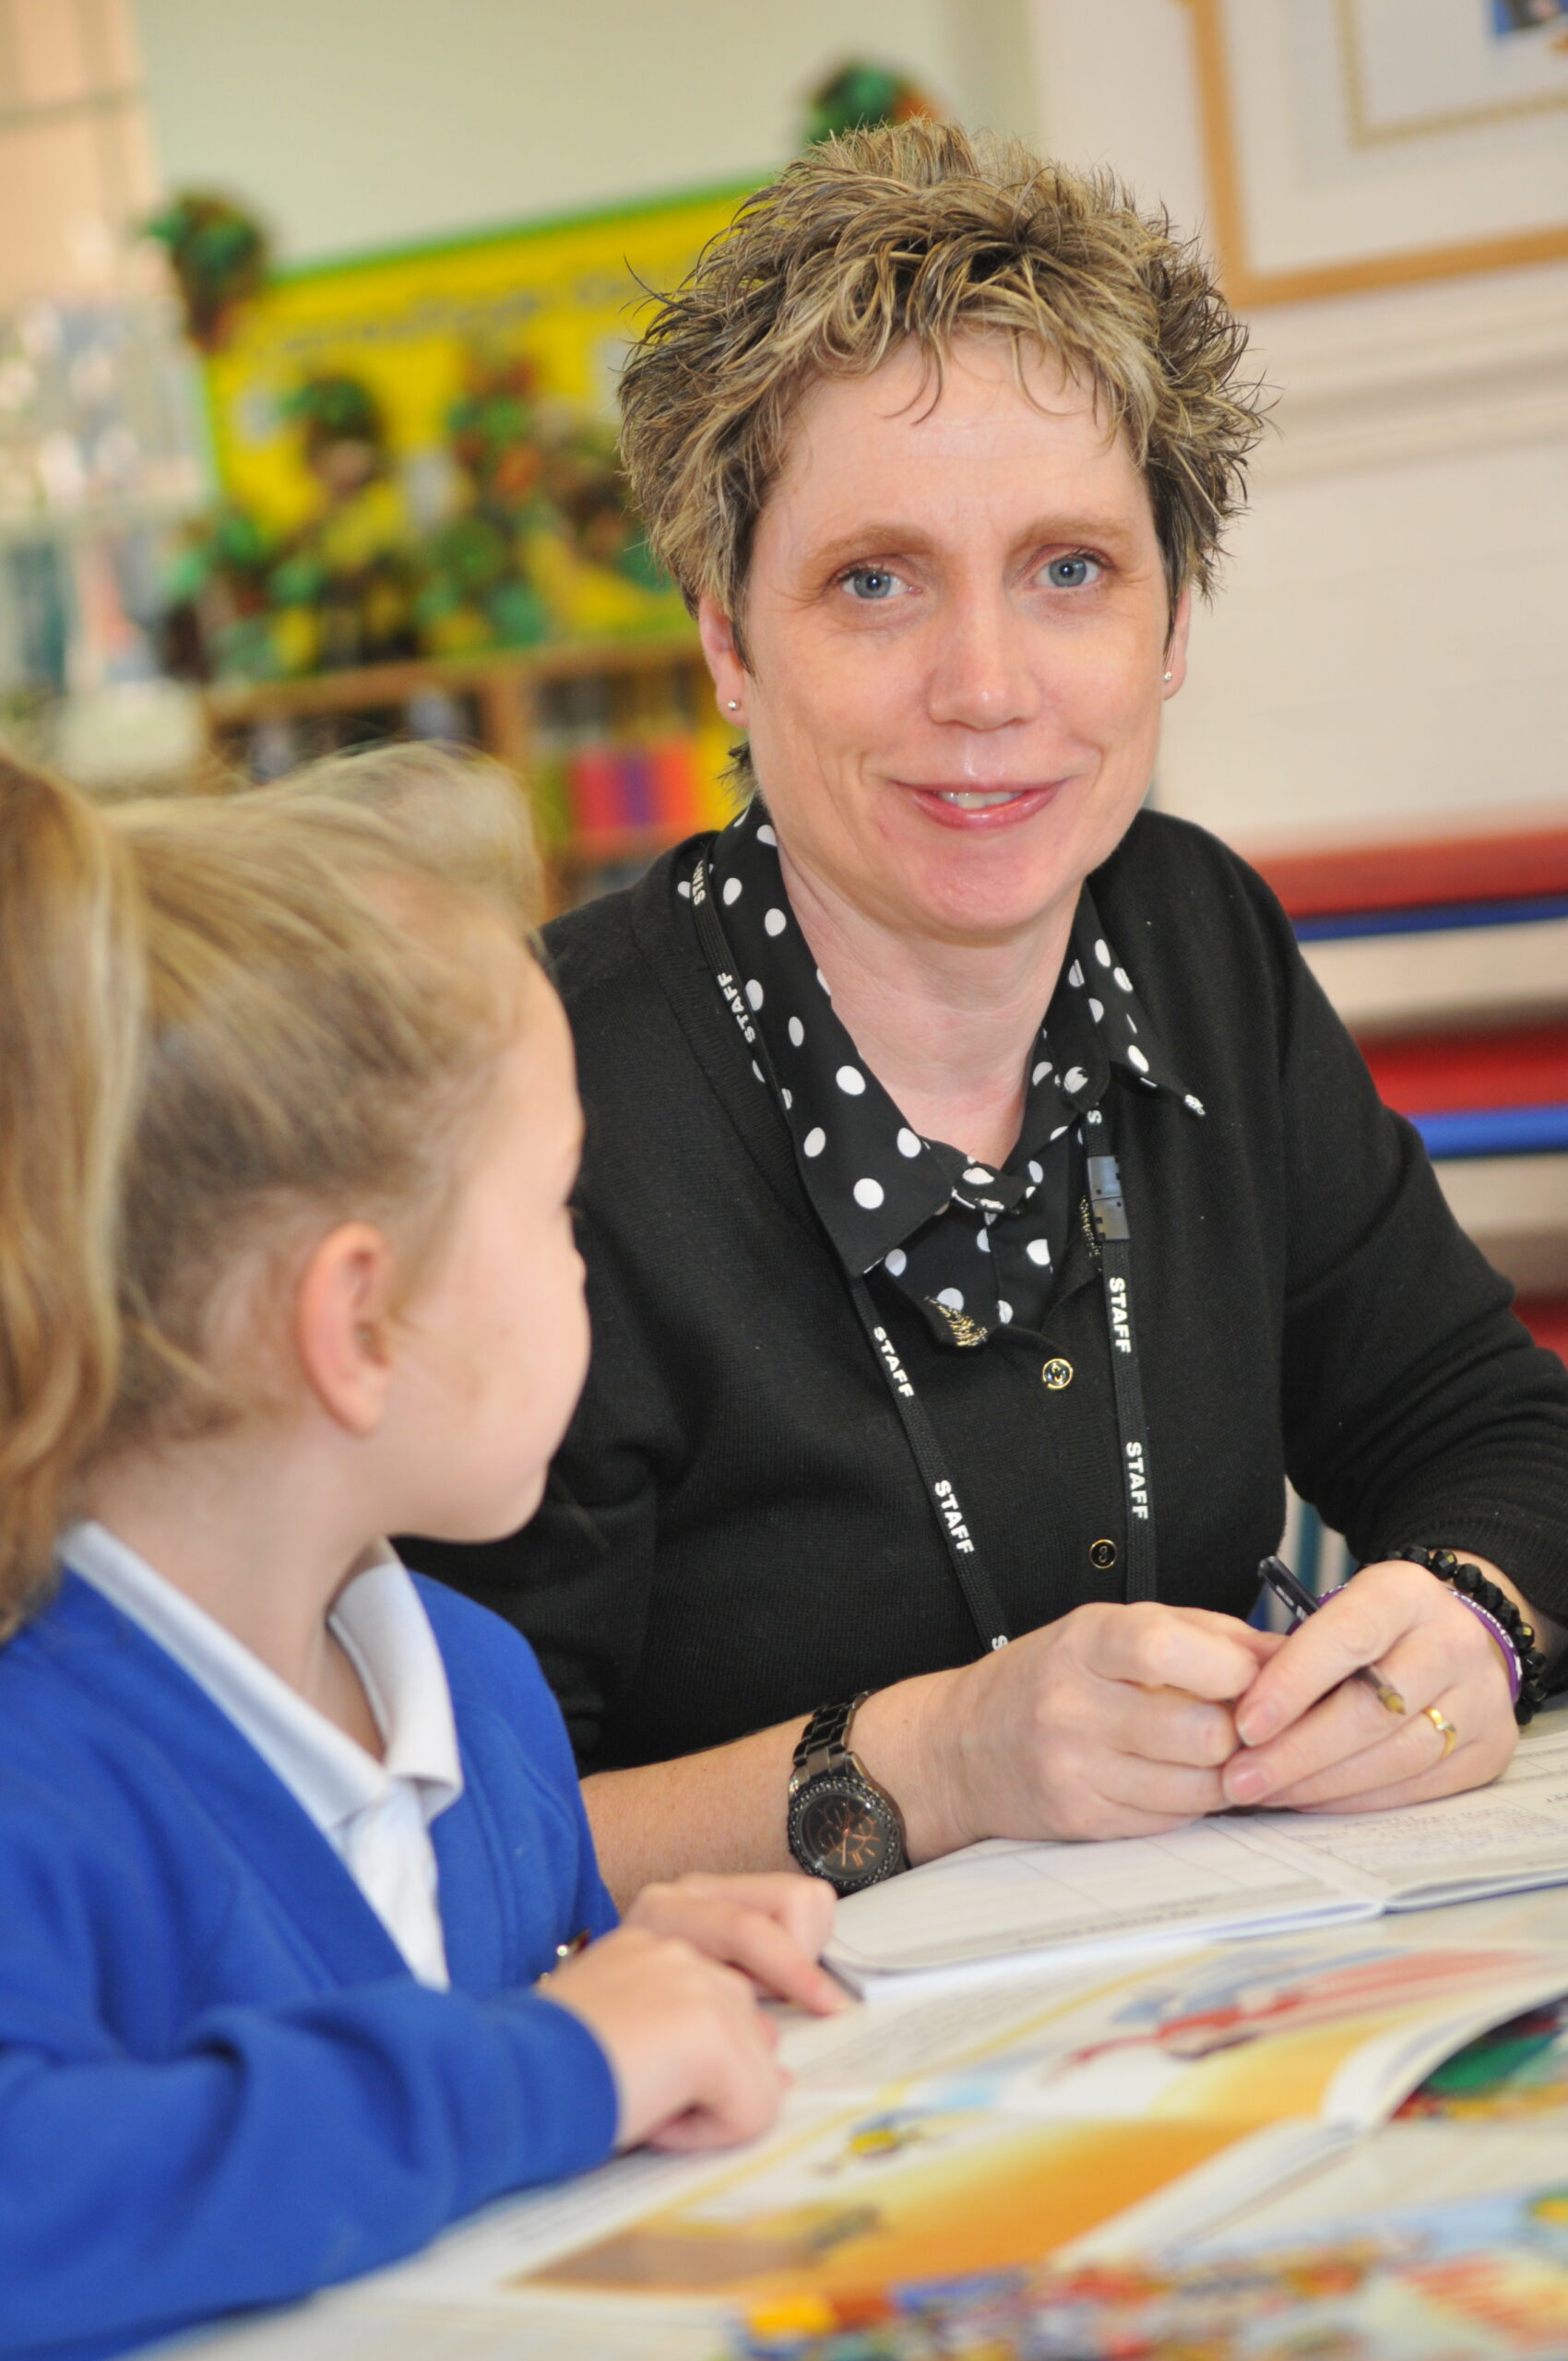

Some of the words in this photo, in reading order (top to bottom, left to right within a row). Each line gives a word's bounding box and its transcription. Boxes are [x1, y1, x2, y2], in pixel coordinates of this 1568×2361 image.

[717, 972, 755, 1043] STAFF
[1109, 1276, 1133, 1354] STAFF
[873, 1326, 915, 1398] STAFF
[933, 1479, 975, 1554] STAFF
[1125, 1441, 1149, 1520] STAFF
